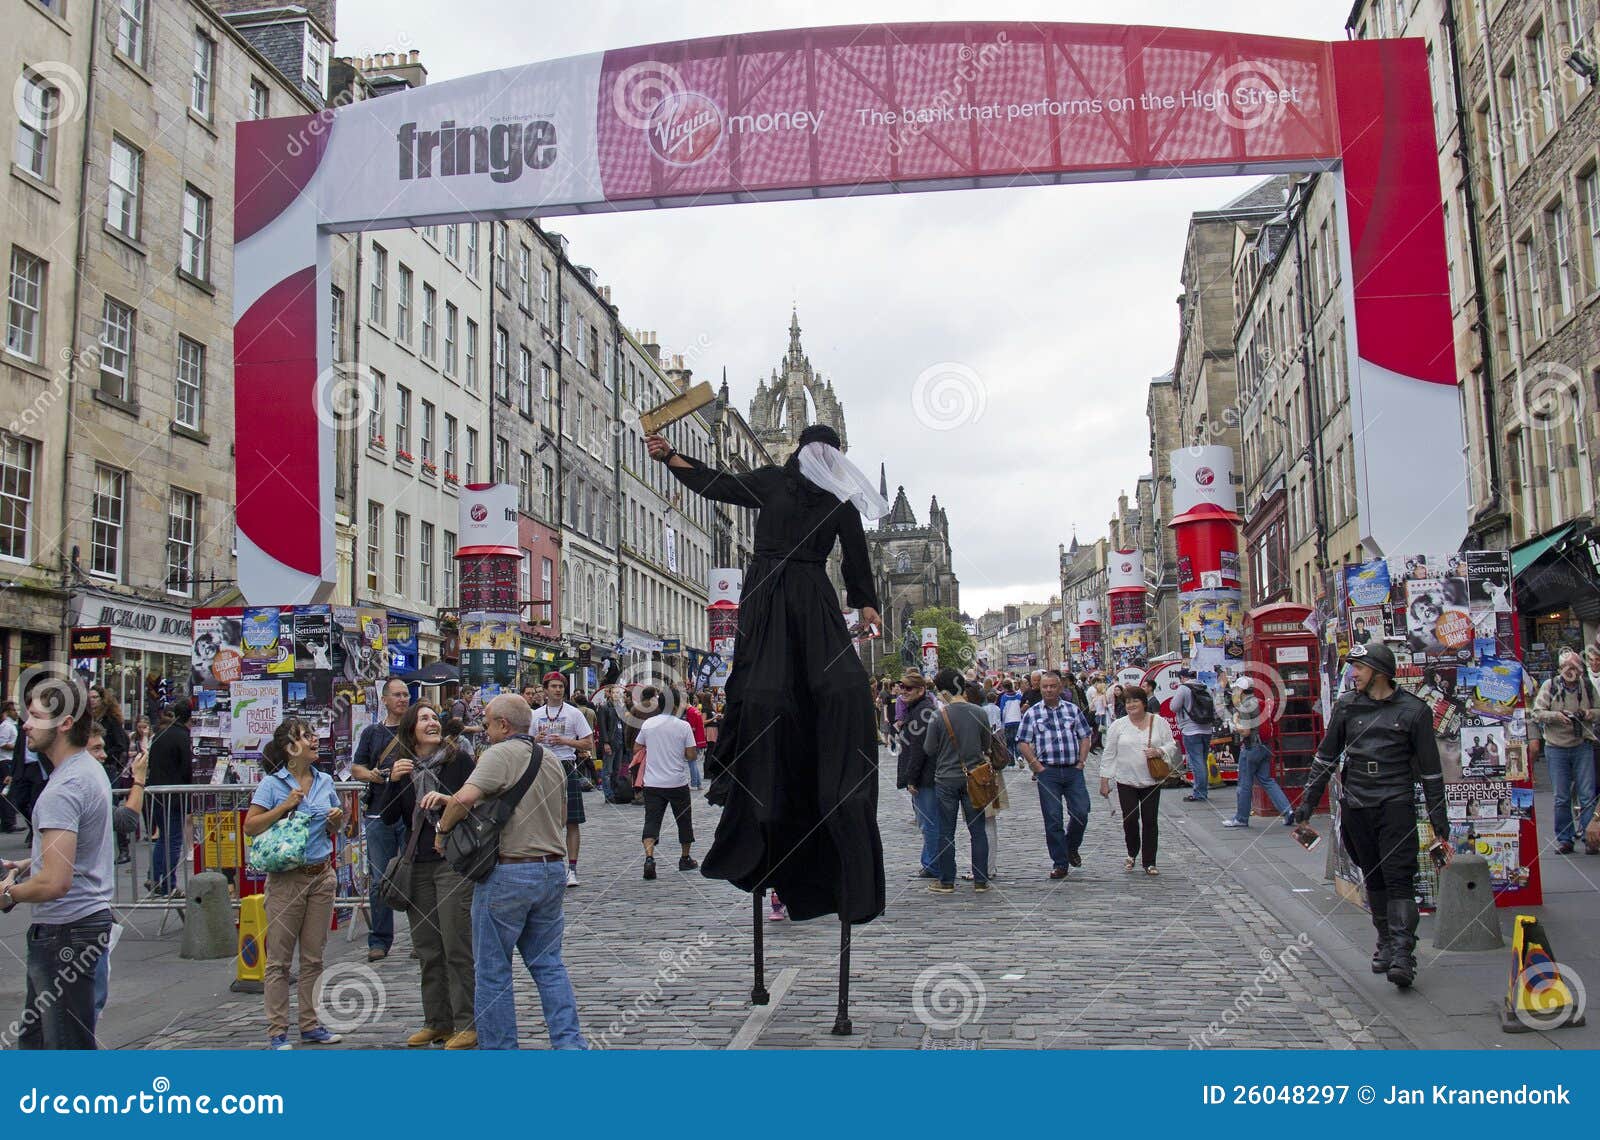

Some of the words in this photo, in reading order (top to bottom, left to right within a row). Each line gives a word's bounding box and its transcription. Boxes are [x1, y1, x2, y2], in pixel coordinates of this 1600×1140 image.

[856, 107, 897, 127] The
[902, 103, 954, 124] bank
[959, 100, 1001, 121] that
[1007, 96, 1102, 121] performs
[1108, 98, 1135, 112] on
[1140, 92, 1175, 111] the
[1180, 89, 1229, 112] High
[1235, 85, 1299, 106] Street
[655, 103, 716, 154] Virgin
[728, 109, 824, 138] money
[397, 119, 557, 183] fringe
[1468, 565, 1509, 574] Settimana
[101, 606, 157, 632] HIGHLAND
[161, 617, 192, 637] HOUS
[295, 626, 331, 635] Settimana
[1444, 791, 1513, 800] IFFERENCES
[1445, 782, 1512, 792] RECONCILABLE
